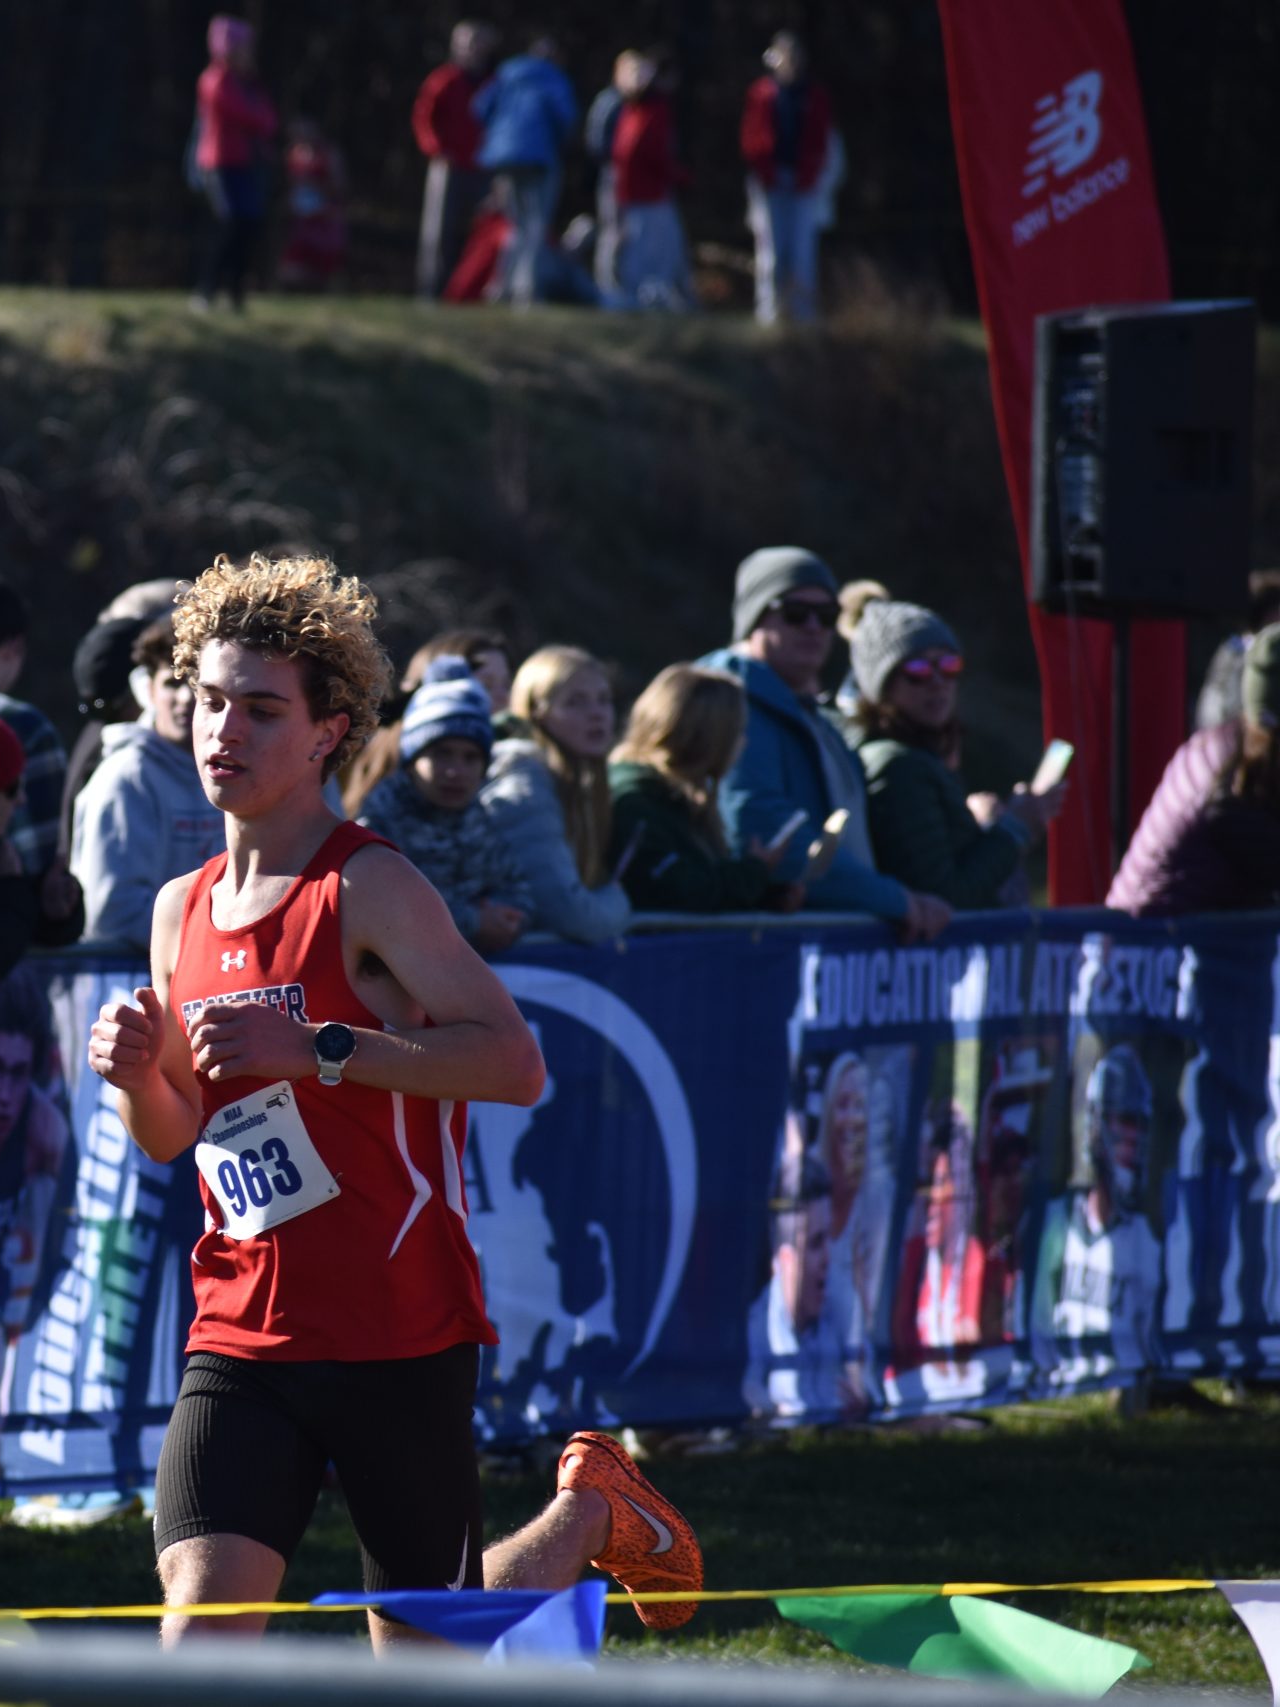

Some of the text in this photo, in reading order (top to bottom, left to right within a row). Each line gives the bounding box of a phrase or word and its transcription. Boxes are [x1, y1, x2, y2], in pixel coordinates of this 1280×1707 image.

[799, 942, 1200, 1030] EDUCATIOAL ATETIC
[212, 1112, 268, 1145] Championships
[223, 1105, 243, 1124] MIAA
[217, 1137, 303, 1217] 963
[20, 1078, 131, 1467] EDUCATIO
[80, 1148, 174, 1438] ATHLETI
